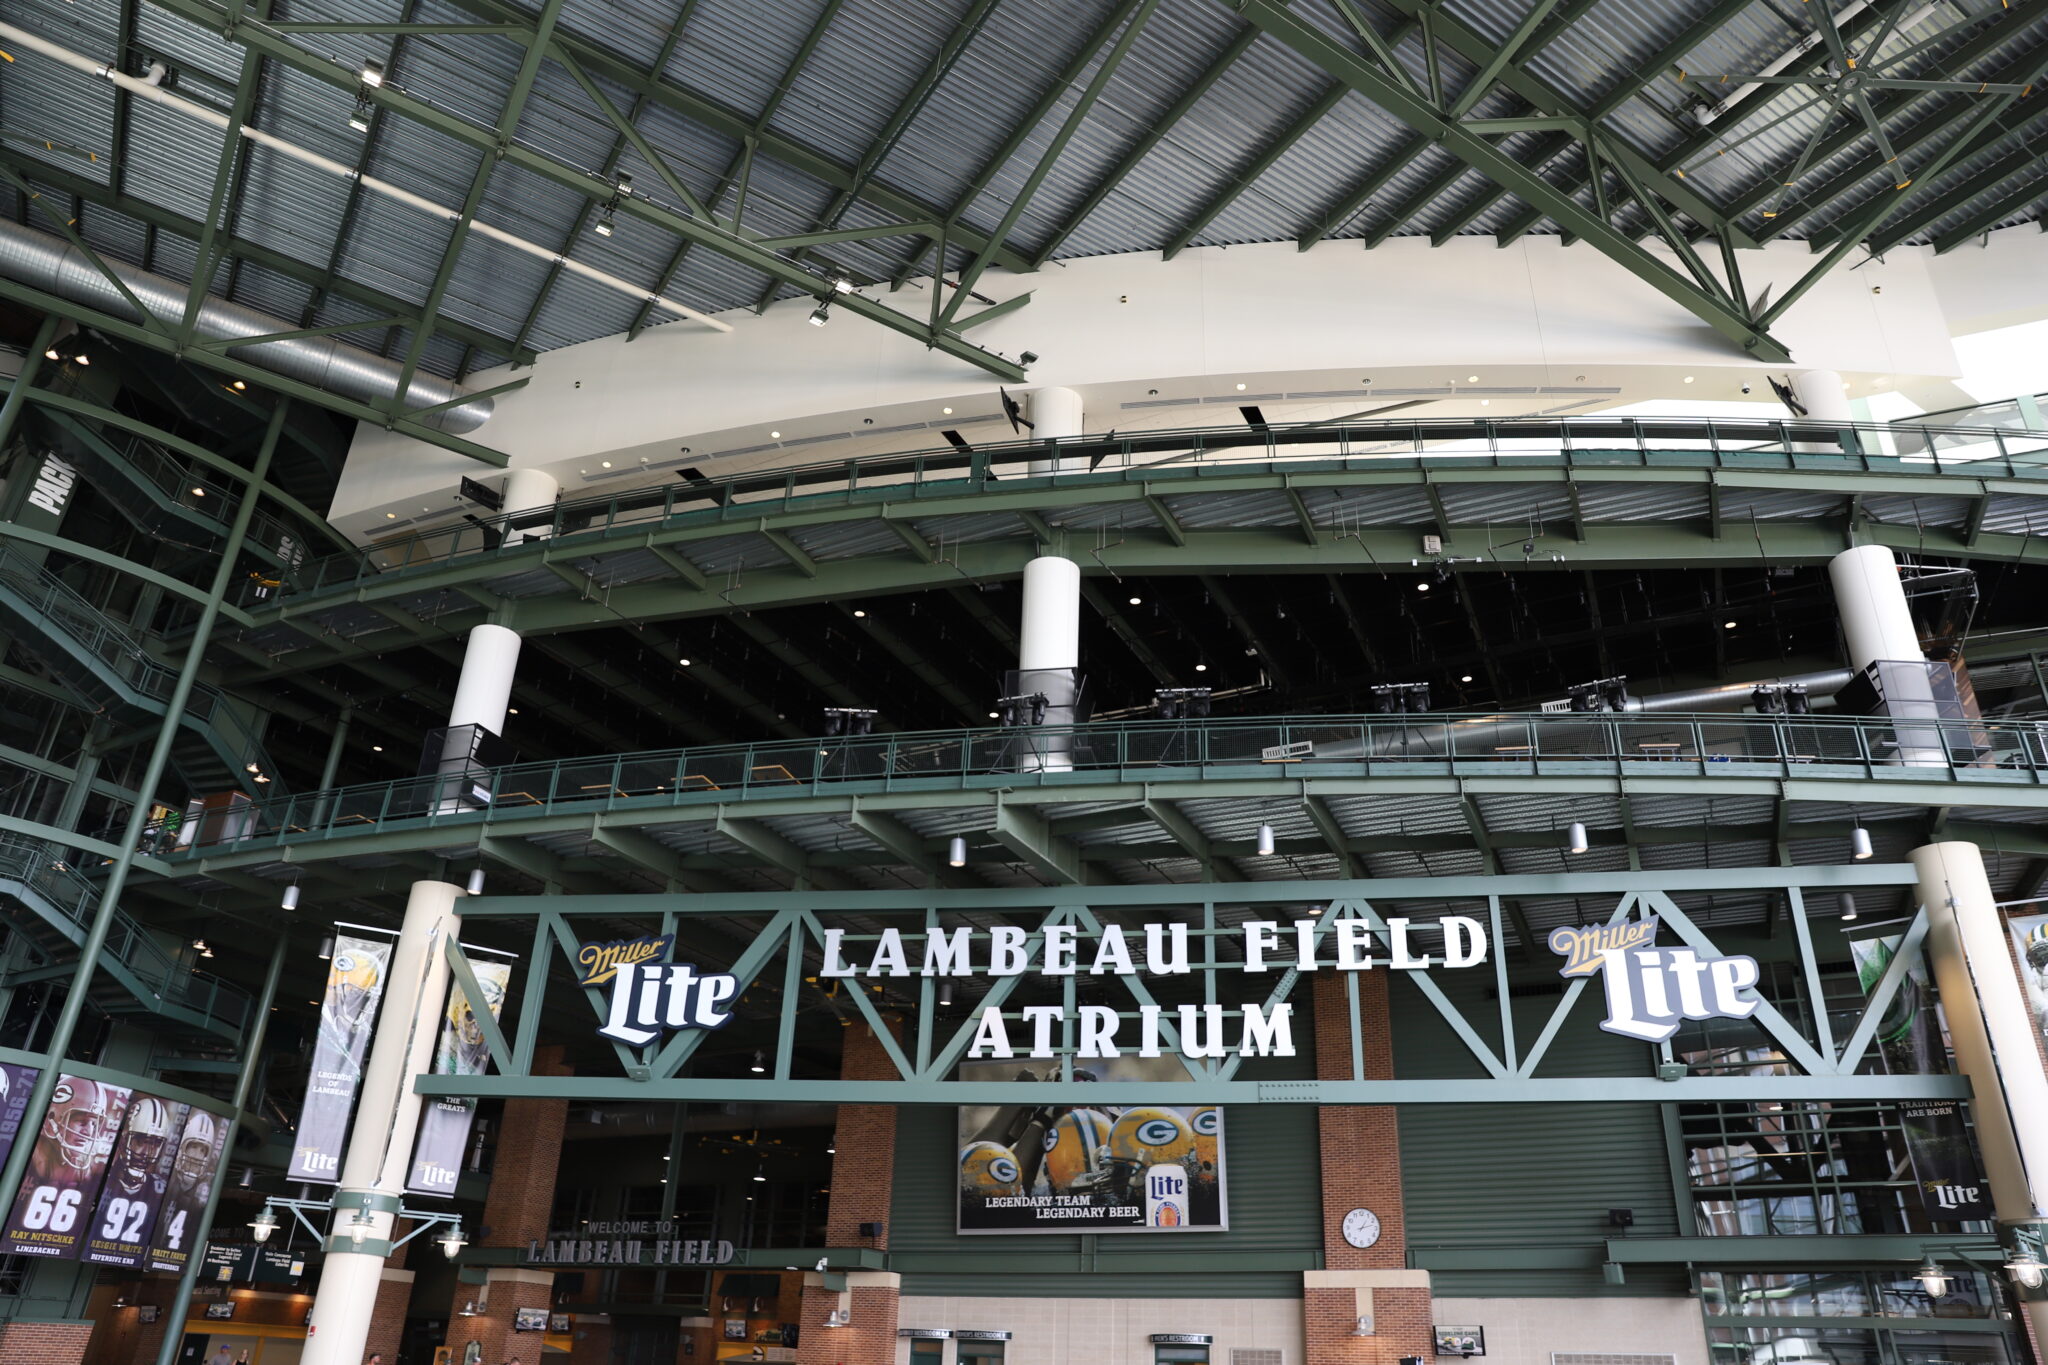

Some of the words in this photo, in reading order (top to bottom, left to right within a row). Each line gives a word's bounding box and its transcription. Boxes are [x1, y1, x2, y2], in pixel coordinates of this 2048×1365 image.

[28, 451, 76, 516] PACK
[820, 923, 1191, 977] LAMBEAU
[1242, 916, 1488, 973] FIELD
[1552, 921, 1654, 972] Miller
[579, 939, 665, 982] Miller
[600, 962, 736, 1044] Lite
[1594, 949, 1758, 1039] Lite
[967, 1003, 1296, 1060] ATRIUM
[317, 1071, 353, 1082] LEGENDS
[312, 1086, 351, 1096] LAMBEAU
[437, 1103, 466, 1112] GREATS
[1907, 1109, 1925, 1117] ARE
[1927, 1107, 1953, 1116] BORN
[301, 1151, 338, 1172] Lite
[422, 1166, 456, 1186] Lite
[1151, 1176, 1183, 1201] Lite
[1934, 1185, 1979, 1209] Lite
[23, 1185, 82, 1233] 66
[985, 1197, 1053, 1208] LEGENDARY
[1056, 1196, 1091, 1206] TEAM
[1036, 1207, 1106, 1219] LEGENDARY
[1109, 1206, 1140, 1217] BEER
[102, 1197, 148, 1243] 92
[167, 1210, 187, 1249] 4
[588, 1221, 649, 1233] WELCOME
[655, 1221, 672, 1233] TO
[10, 1230, 30, 1240] RAY
[30, 1232, 75, 1245] NITSCHKE
[15, 1245, 61, 1255] LINEBACKER
[90, 1253, 122, 1263] DEFENSIVE
[122, 1257, 135, 1265] END
[526, 1240, 642, 1264] LAMBEAU
[653, 1240, 734, 1265] FIELD
